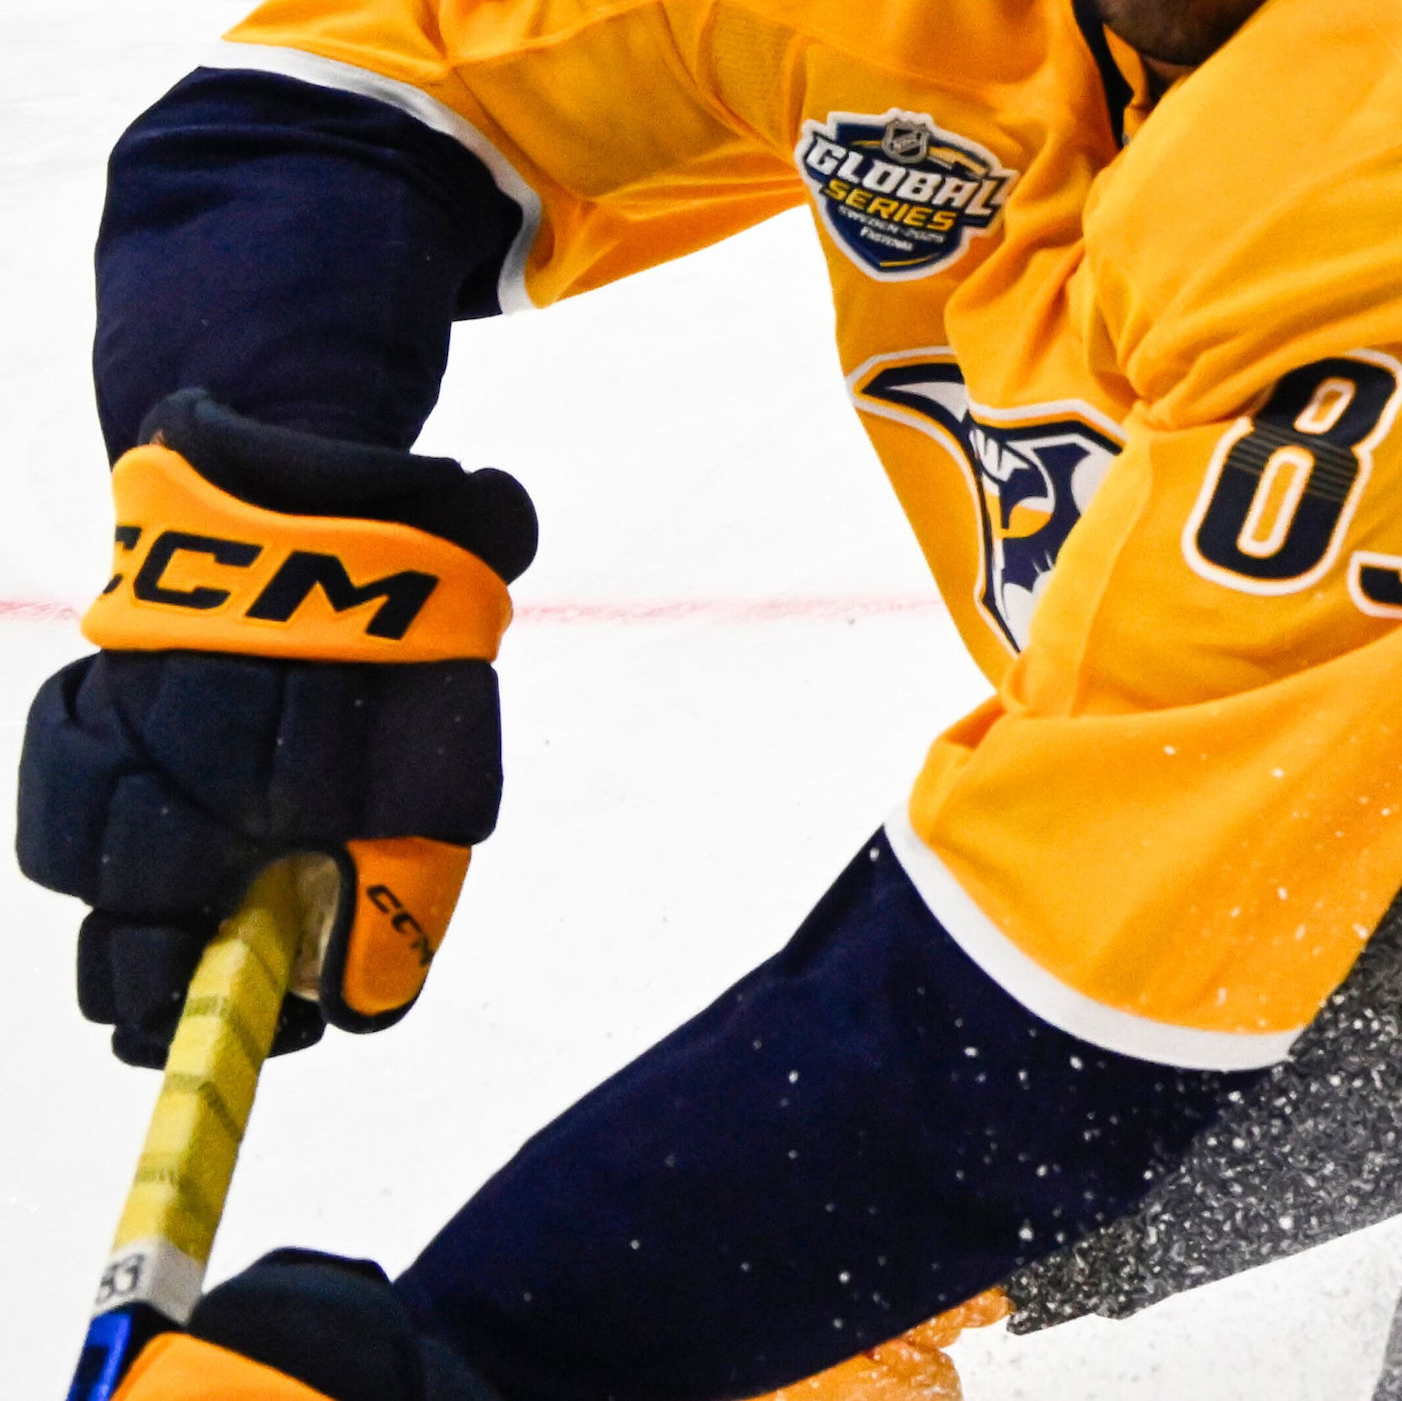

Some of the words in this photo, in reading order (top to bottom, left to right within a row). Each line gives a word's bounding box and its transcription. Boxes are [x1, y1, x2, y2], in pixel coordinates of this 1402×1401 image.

[805, 135, 1008, 216] GLOBAL
[824, 178, 957, 232] SERIES
[366, 882, 436, 967] CCM
